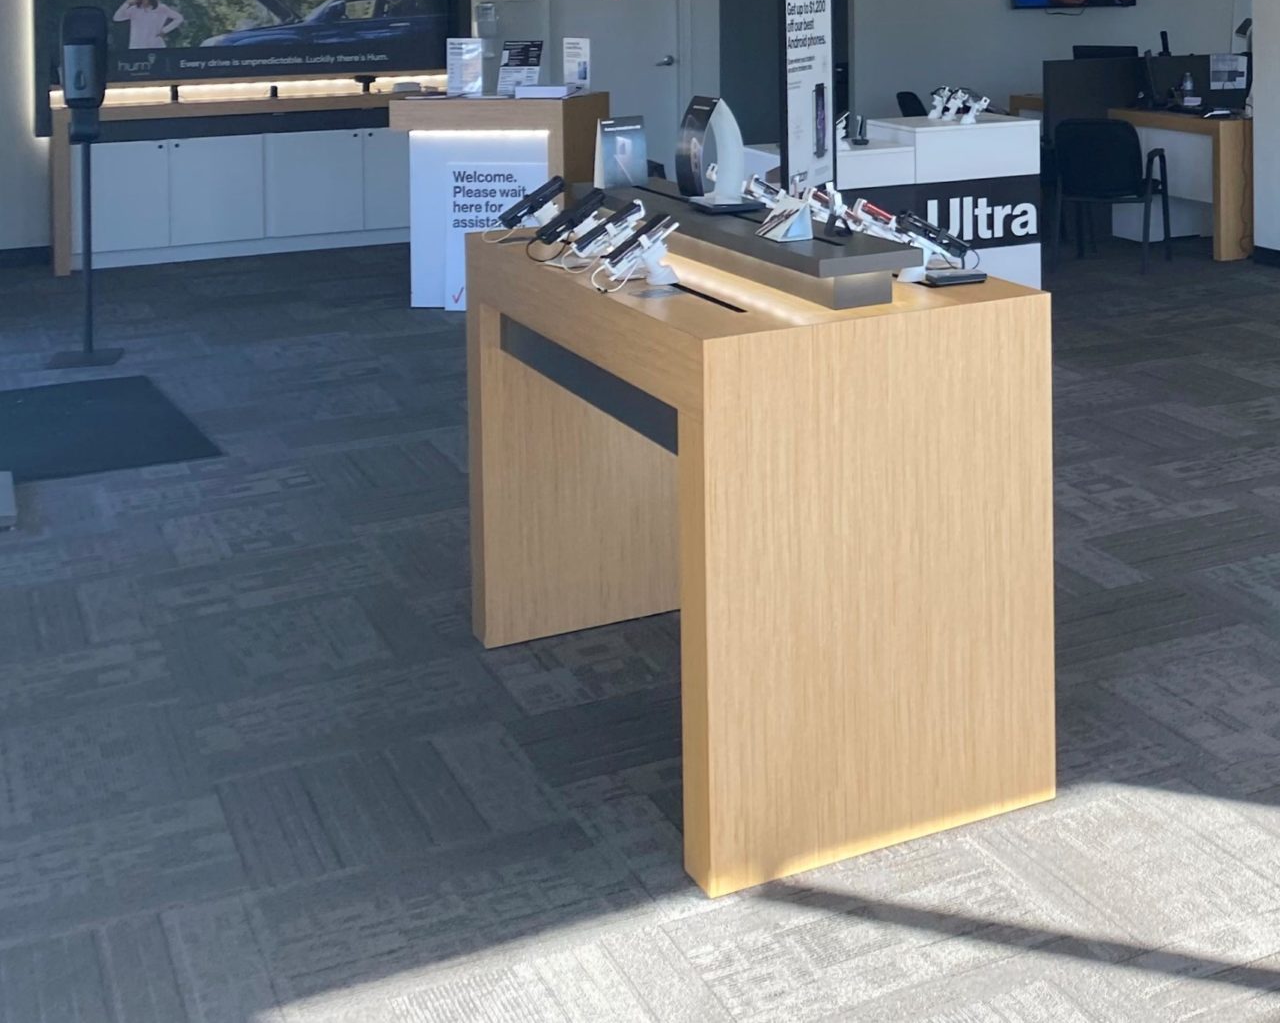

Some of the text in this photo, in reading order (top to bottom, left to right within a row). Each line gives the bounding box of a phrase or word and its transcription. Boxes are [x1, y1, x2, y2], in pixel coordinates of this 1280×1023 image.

[117, 61, 151, 72] hum
[179, 59, 206, 69] Every
[207, 58, 230, 67] drive
[232, 57, 240, 66] is
[452, 170, 518, 183] Welcome.
[453, 185, 527, 198] Please wait
[453, 200, 504, 213] here for
[926, 196, 1038, 241] Ultra
